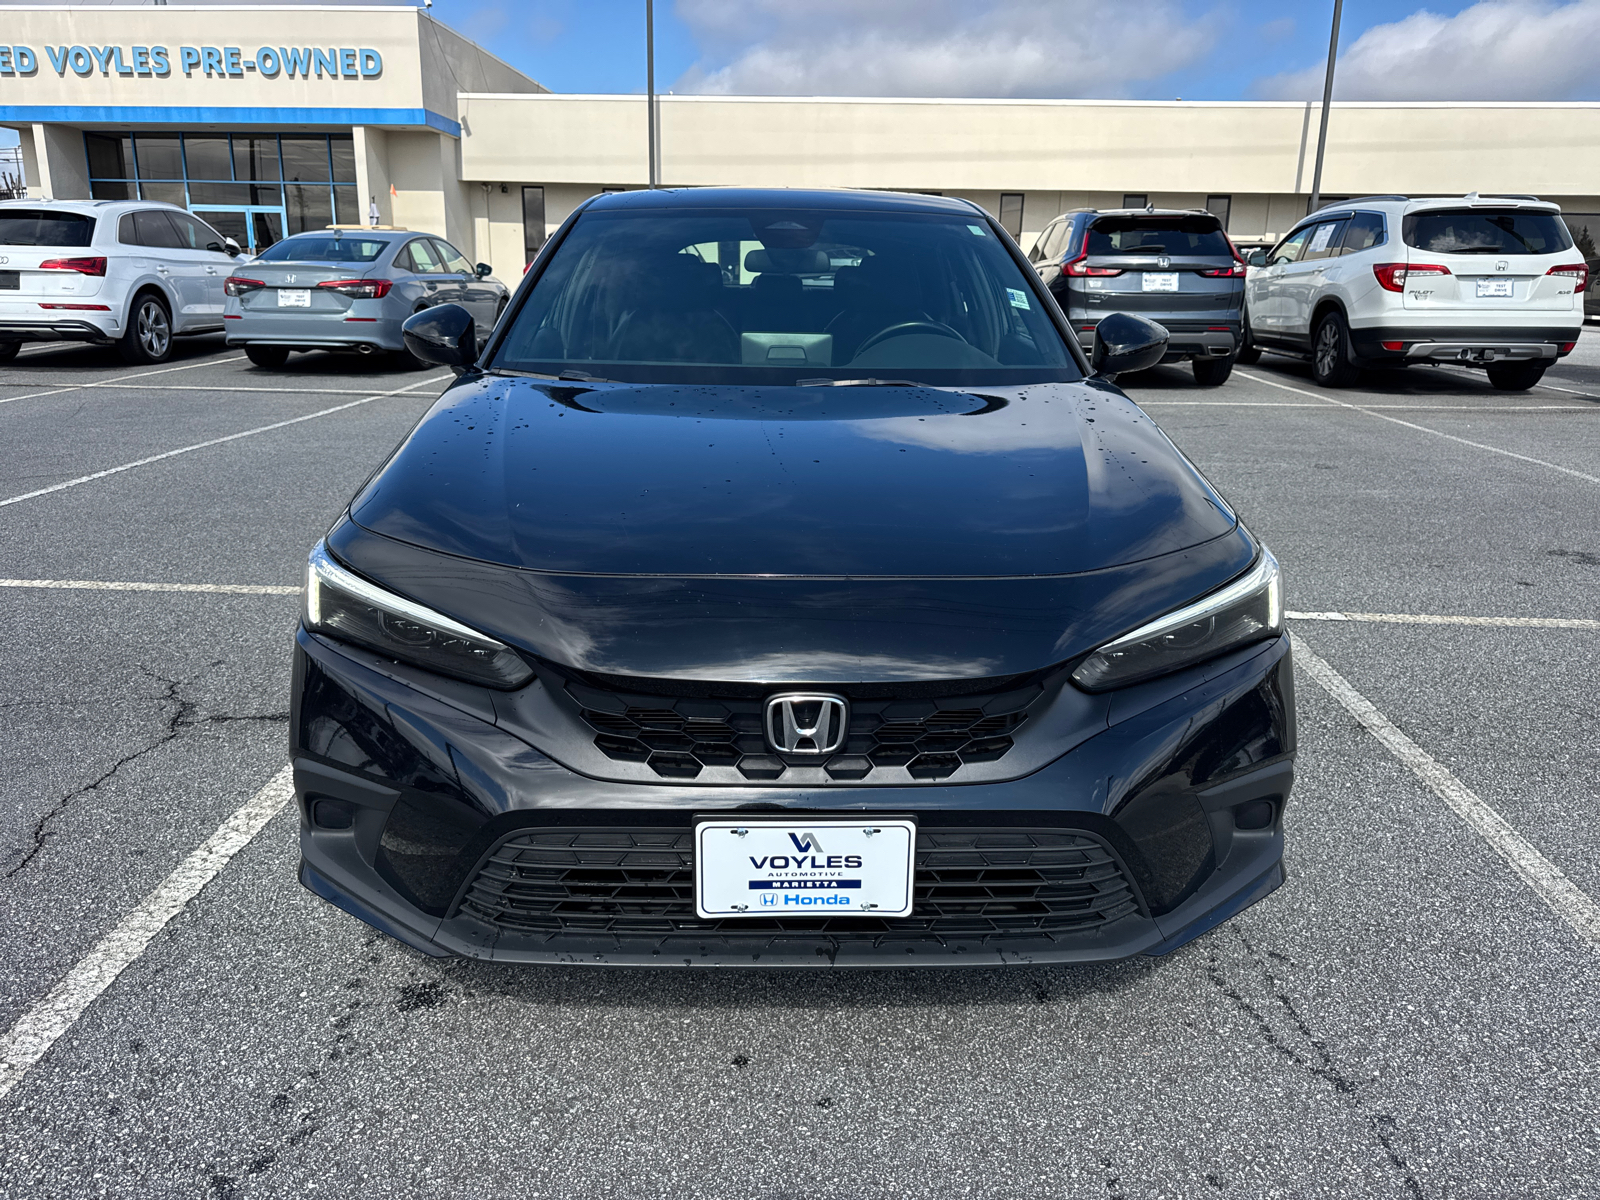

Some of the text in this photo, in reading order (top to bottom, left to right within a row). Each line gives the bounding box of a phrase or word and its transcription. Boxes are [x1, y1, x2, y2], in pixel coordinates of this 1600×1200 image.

[0, 45, 383, 80] ED VOYLES PRE-OWNED
[749, 855, 863, 869] VOYLES
[784, 894, 850, 905] Honda
